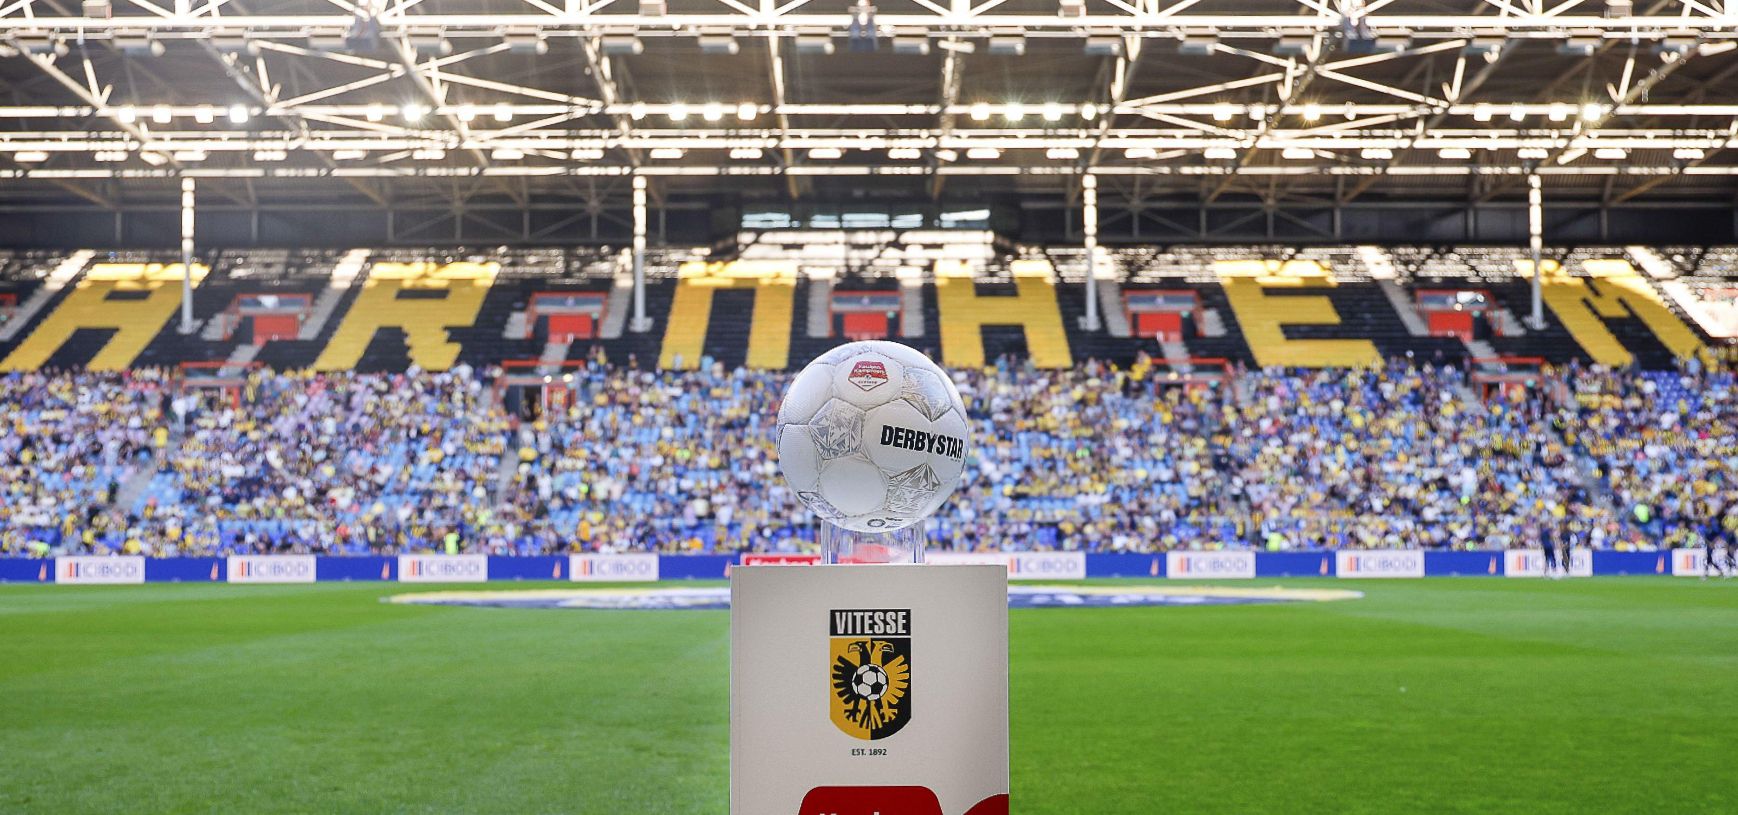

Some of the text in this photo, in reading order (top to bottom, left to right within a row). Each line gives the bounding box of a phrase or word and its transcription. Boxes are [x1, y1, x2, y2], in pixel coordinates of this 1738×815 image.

[880, 425, 964, 459] DERBYSTAR
[835, 611, 907, 634] VITESSE
[851, 748, 887, 756] EST. 1892
